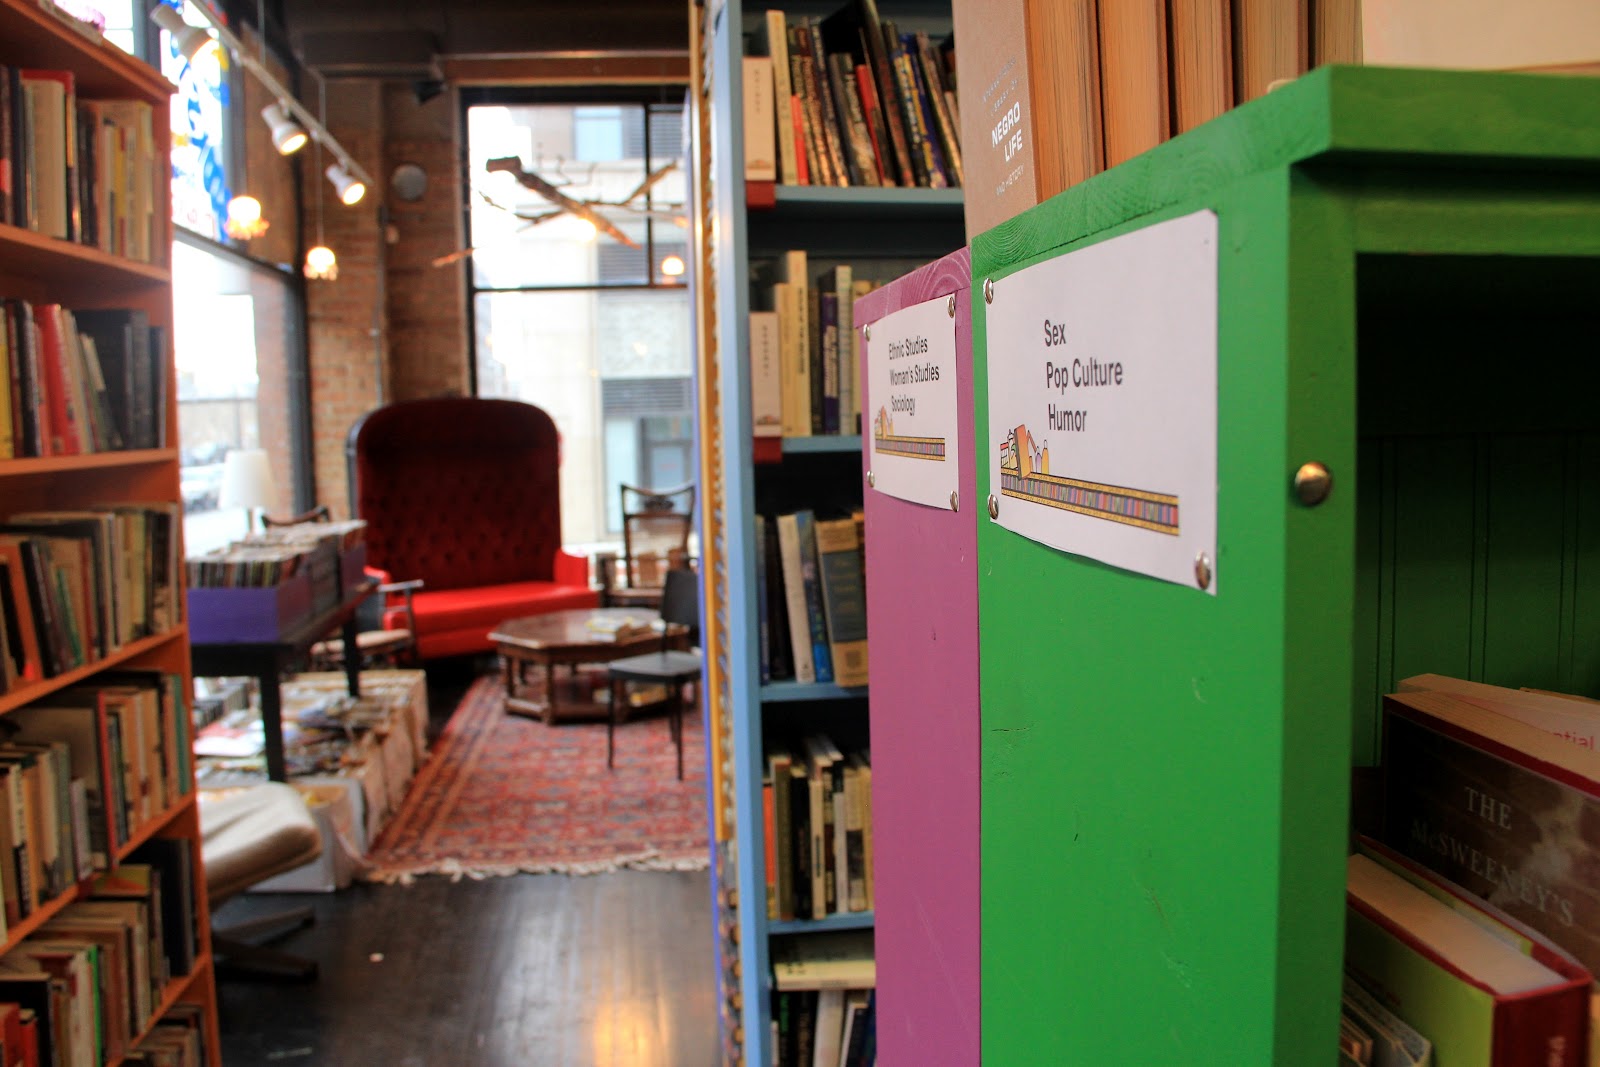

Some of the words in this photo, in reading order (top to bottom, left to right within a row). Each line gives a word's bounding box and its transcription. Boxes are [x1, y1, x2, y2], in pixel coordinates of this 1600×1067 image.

[991, 101, 1021, 148] NEGRO
[1004, 128, 1023, 162] LIFE
[888, 341, 904, 360] Ethnic
[905, 335, 928, 357] Studies
[1044, 319, 1066, 347] Sex
[889, 366, 914, 386] Woman's
[914, 362, 940, 383] Studies
[1046, 361, 1068, 395] Pop
[1072, 357, 1123, 387] Culture
[891, 393, 916, 416] Sociology
[1048, 403, 1087, 432] Humor
[1464, 786, 1513, 831] THE
[1411, 817, 1575, 928] McSWEENEY'S
